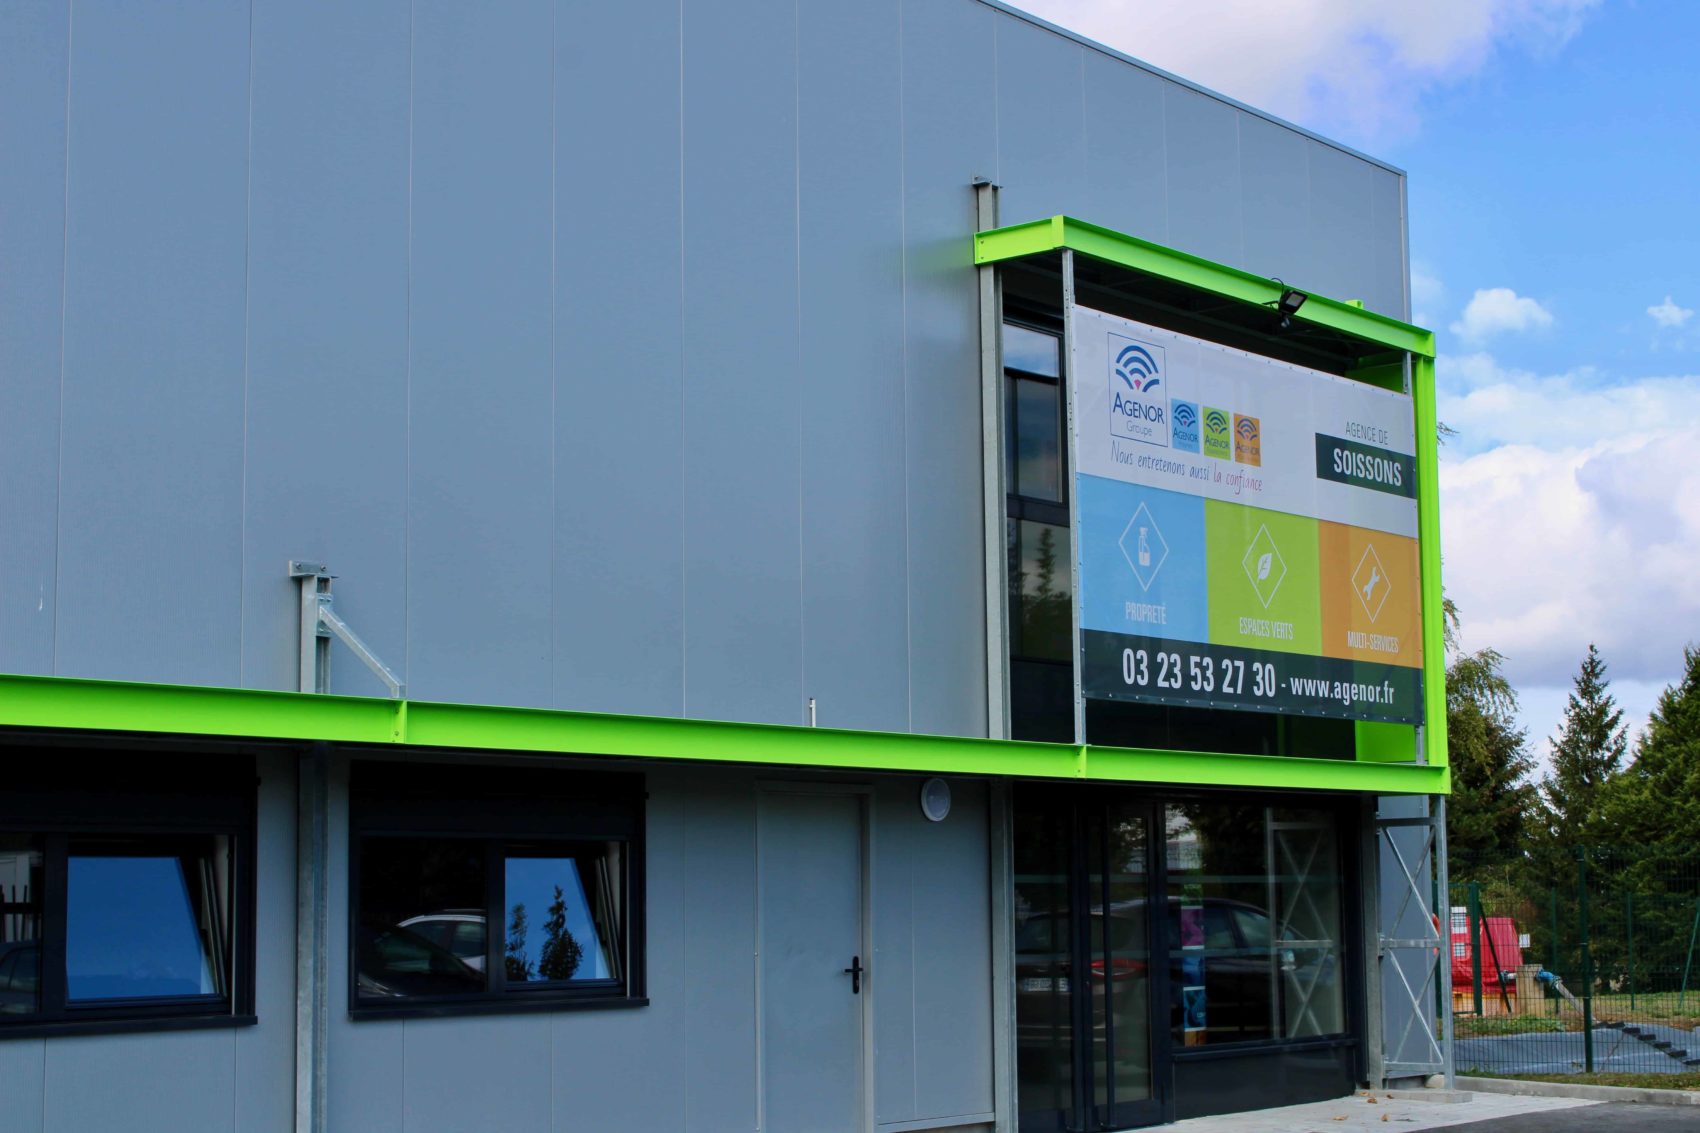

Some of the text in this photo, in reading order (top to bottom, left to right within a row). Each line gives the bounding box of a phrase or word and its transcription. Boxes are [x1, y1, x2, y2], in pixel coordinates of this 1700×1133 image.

[1113, 392, 1165, 424] AGENOR
[1126, 420, 1153, 437] Groupe
[1345, 421, 1388, 445] AGENCE DE
[1110, 440, 1263, 495] Nous entretenons aussi la confiance
[1333, 447, 1402, 487] SOISSONS
[1239, 617, 1294, 641] ESPACES VERTS
[1347, 631, 1399, 653] MULTI-SERVICES
[1122, 648, 1149, 686] 03
[1156, 652, 1182, 689] 23
[1190, 655, 1215, 692] 53
[1221, 659, 1245, 694] 27
[1252, 662, 1276, 698] 30
[1290, 676, 1395, 706] www.agenor.fr
